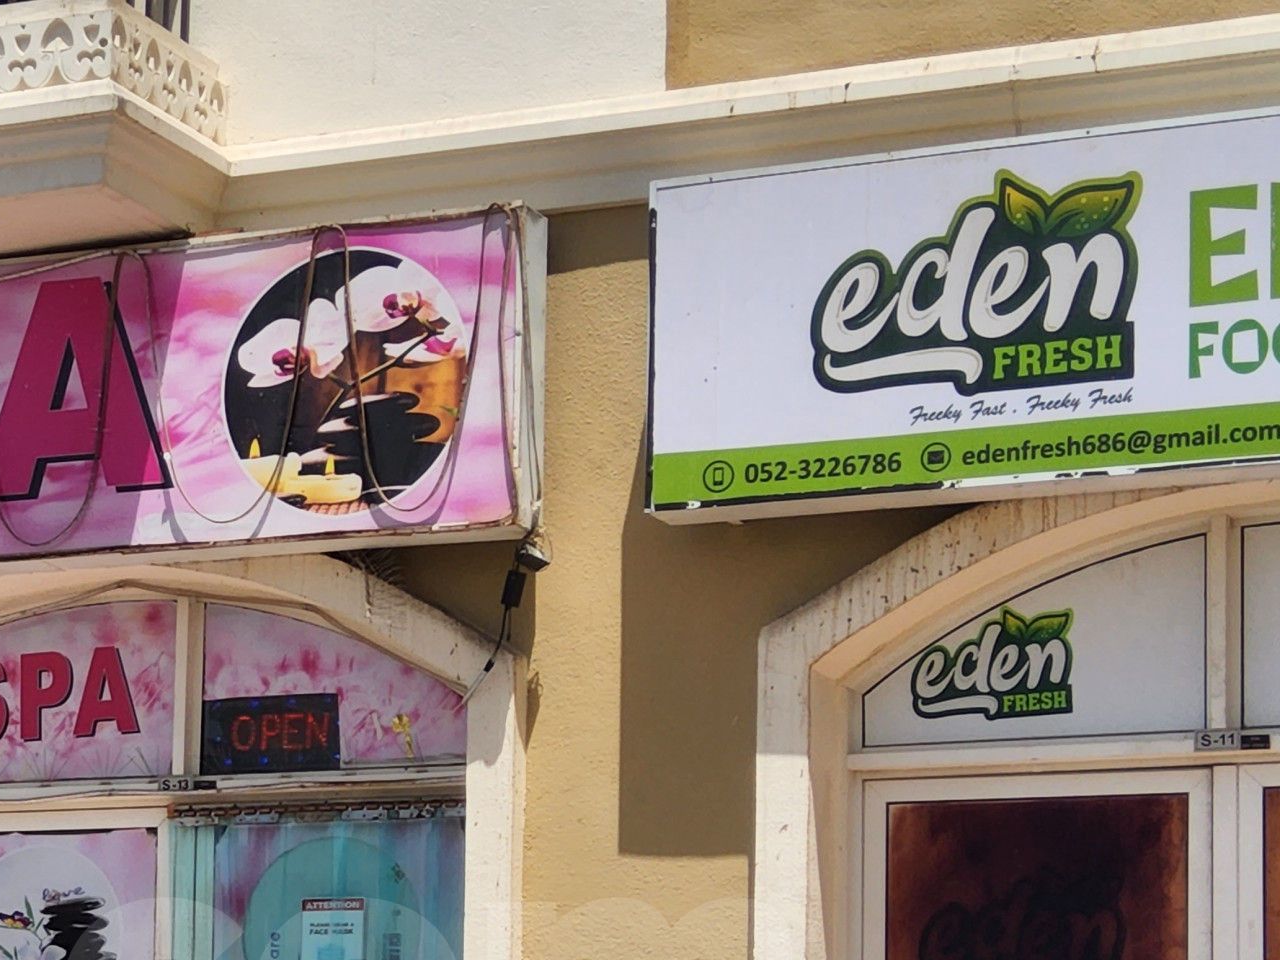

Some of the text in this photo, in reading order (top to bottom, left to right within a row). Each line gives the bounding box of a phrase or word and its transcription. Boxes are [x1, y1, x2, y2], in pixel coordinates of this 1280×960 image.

[1189, 182, 1280, 308] E
[818, 205, 1128, 358] eden
[992, 335, 1122, 381] FRESH
[1188, 318, 1280, 379] FO
[909, 403, 962, 426] Freeky
[970, 400, 1008, 420] Fast
[1026, 392, 1081, 415] Freeky
[1088, 387, 1133, 409] Fresh
[961, 423, 1280, 466] edenfresh686@gmail.com
[744, 451, 902, 484] 052-3226786
[916, 622, 1068, 695] eden
[1002, 691, 1067, 713] FRESH
[231, 711, 330, 752] OPEN
[1200, 732, 1235, 747] S-11
[162, 778, 189, 791] S-13
[306, 900, 360, 910] ATTENTION
